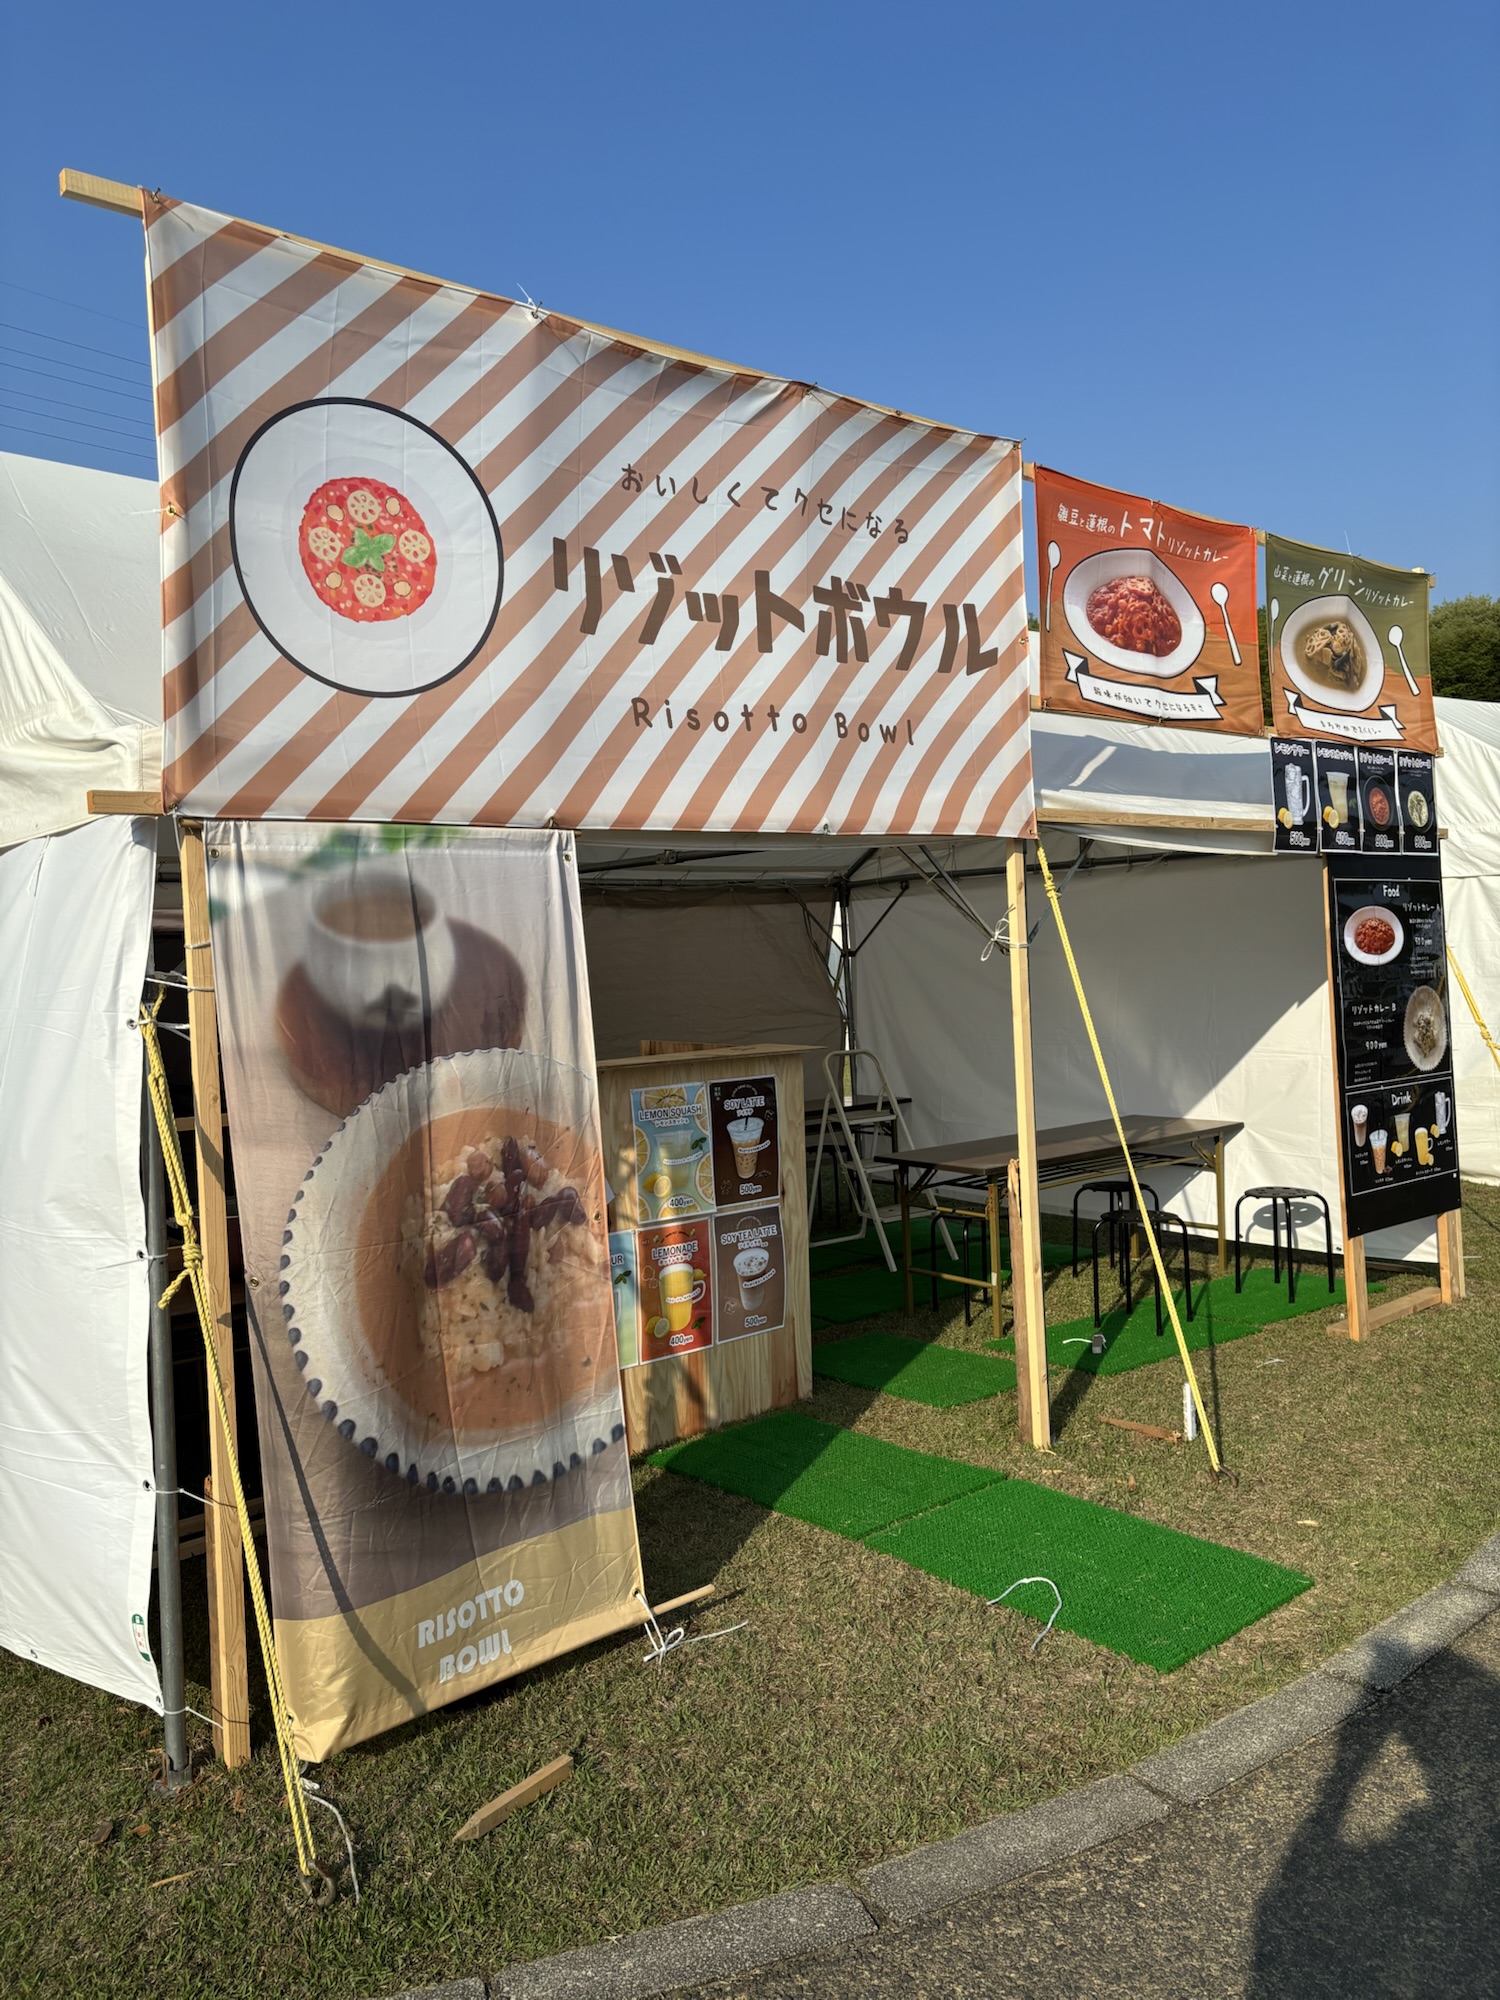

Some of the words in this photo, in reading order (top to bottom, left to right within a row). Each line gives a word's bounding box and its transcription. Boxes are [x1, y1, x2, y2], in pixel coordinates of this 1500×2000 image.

[621, 463, 909, 544] おいしくてクセになる
[552, 537, 998, 676] リゾットボウル
[631, 697, 808, 734] Risotto
[835, 711, 915, 746] Bowl
[1383, 884, 1400, 897] Food
[724, 1099, 740, 1110] SOY
[740, 1096, 765, 1109] LATTE
[1391, 1091, 1412, 1106] Drink
[639, 1108, 669, 1121] LEMON
[670, 1104, 702, 1117] SQUASH
[655, 1118, 690, 1127] レモンスカッシュ
[740, 1183, 762, 1195] 500yen
[669, 1197, 694, 1207] 400yen
[721, 1233, 737, 1245] SOY
[738, 1229, 753, 1241] TEA
[753, 1224, 777, 1239] LATTE
[652, 1240, 698, 1260] LEMONADE
[611, 1254, 624, 1265] UR
[744, 1315, 767, 1328] 500yen
[669, 1334, 694, 1346] 400yen
[418, 1579, 525, 1648] RISOTTO
[439, 1629, 512, 1684] BOWL
